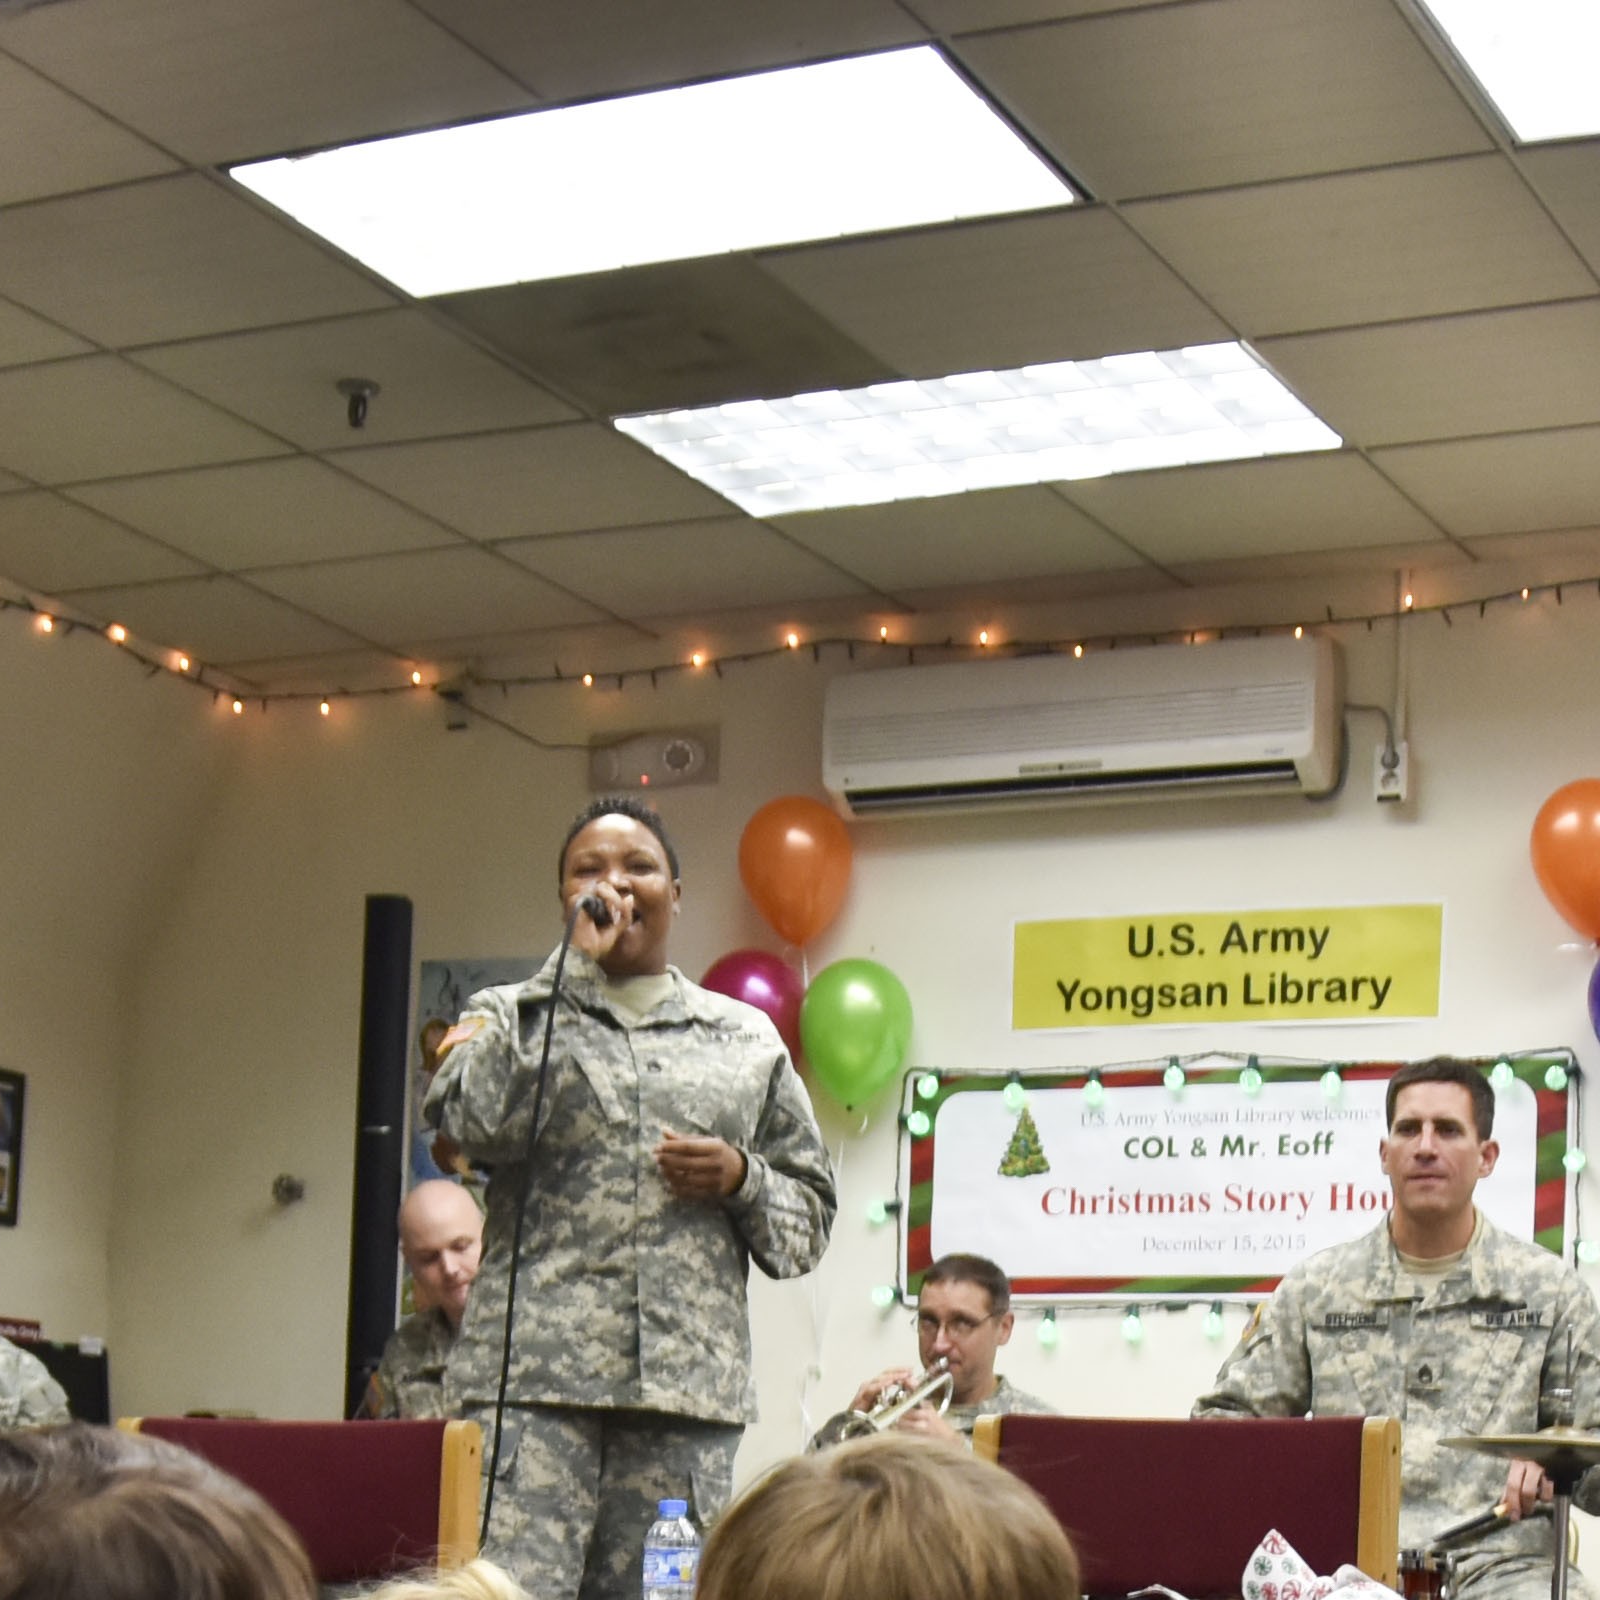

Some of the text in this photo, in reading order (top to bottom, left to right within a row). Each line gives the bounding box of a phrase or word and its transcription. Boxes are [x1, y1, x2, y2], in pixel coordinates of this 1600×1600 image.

[1127, 920, 1331, 960] U.S. Army
[1056, 971, 1393, 1018] Yongsan Library
[1080, 1106, 1382, 1129] U.S. Army Yongsan Library welcomes
[1123, 1130, 1336, 1160] COL & Mr. Eoff
[1041, 1182, 1394, 1221] Christmas Story Hou
[1142, 1233, 1307, 1253] December 15, 2015
[1509, 1311, 1542, 1325] ARMY
